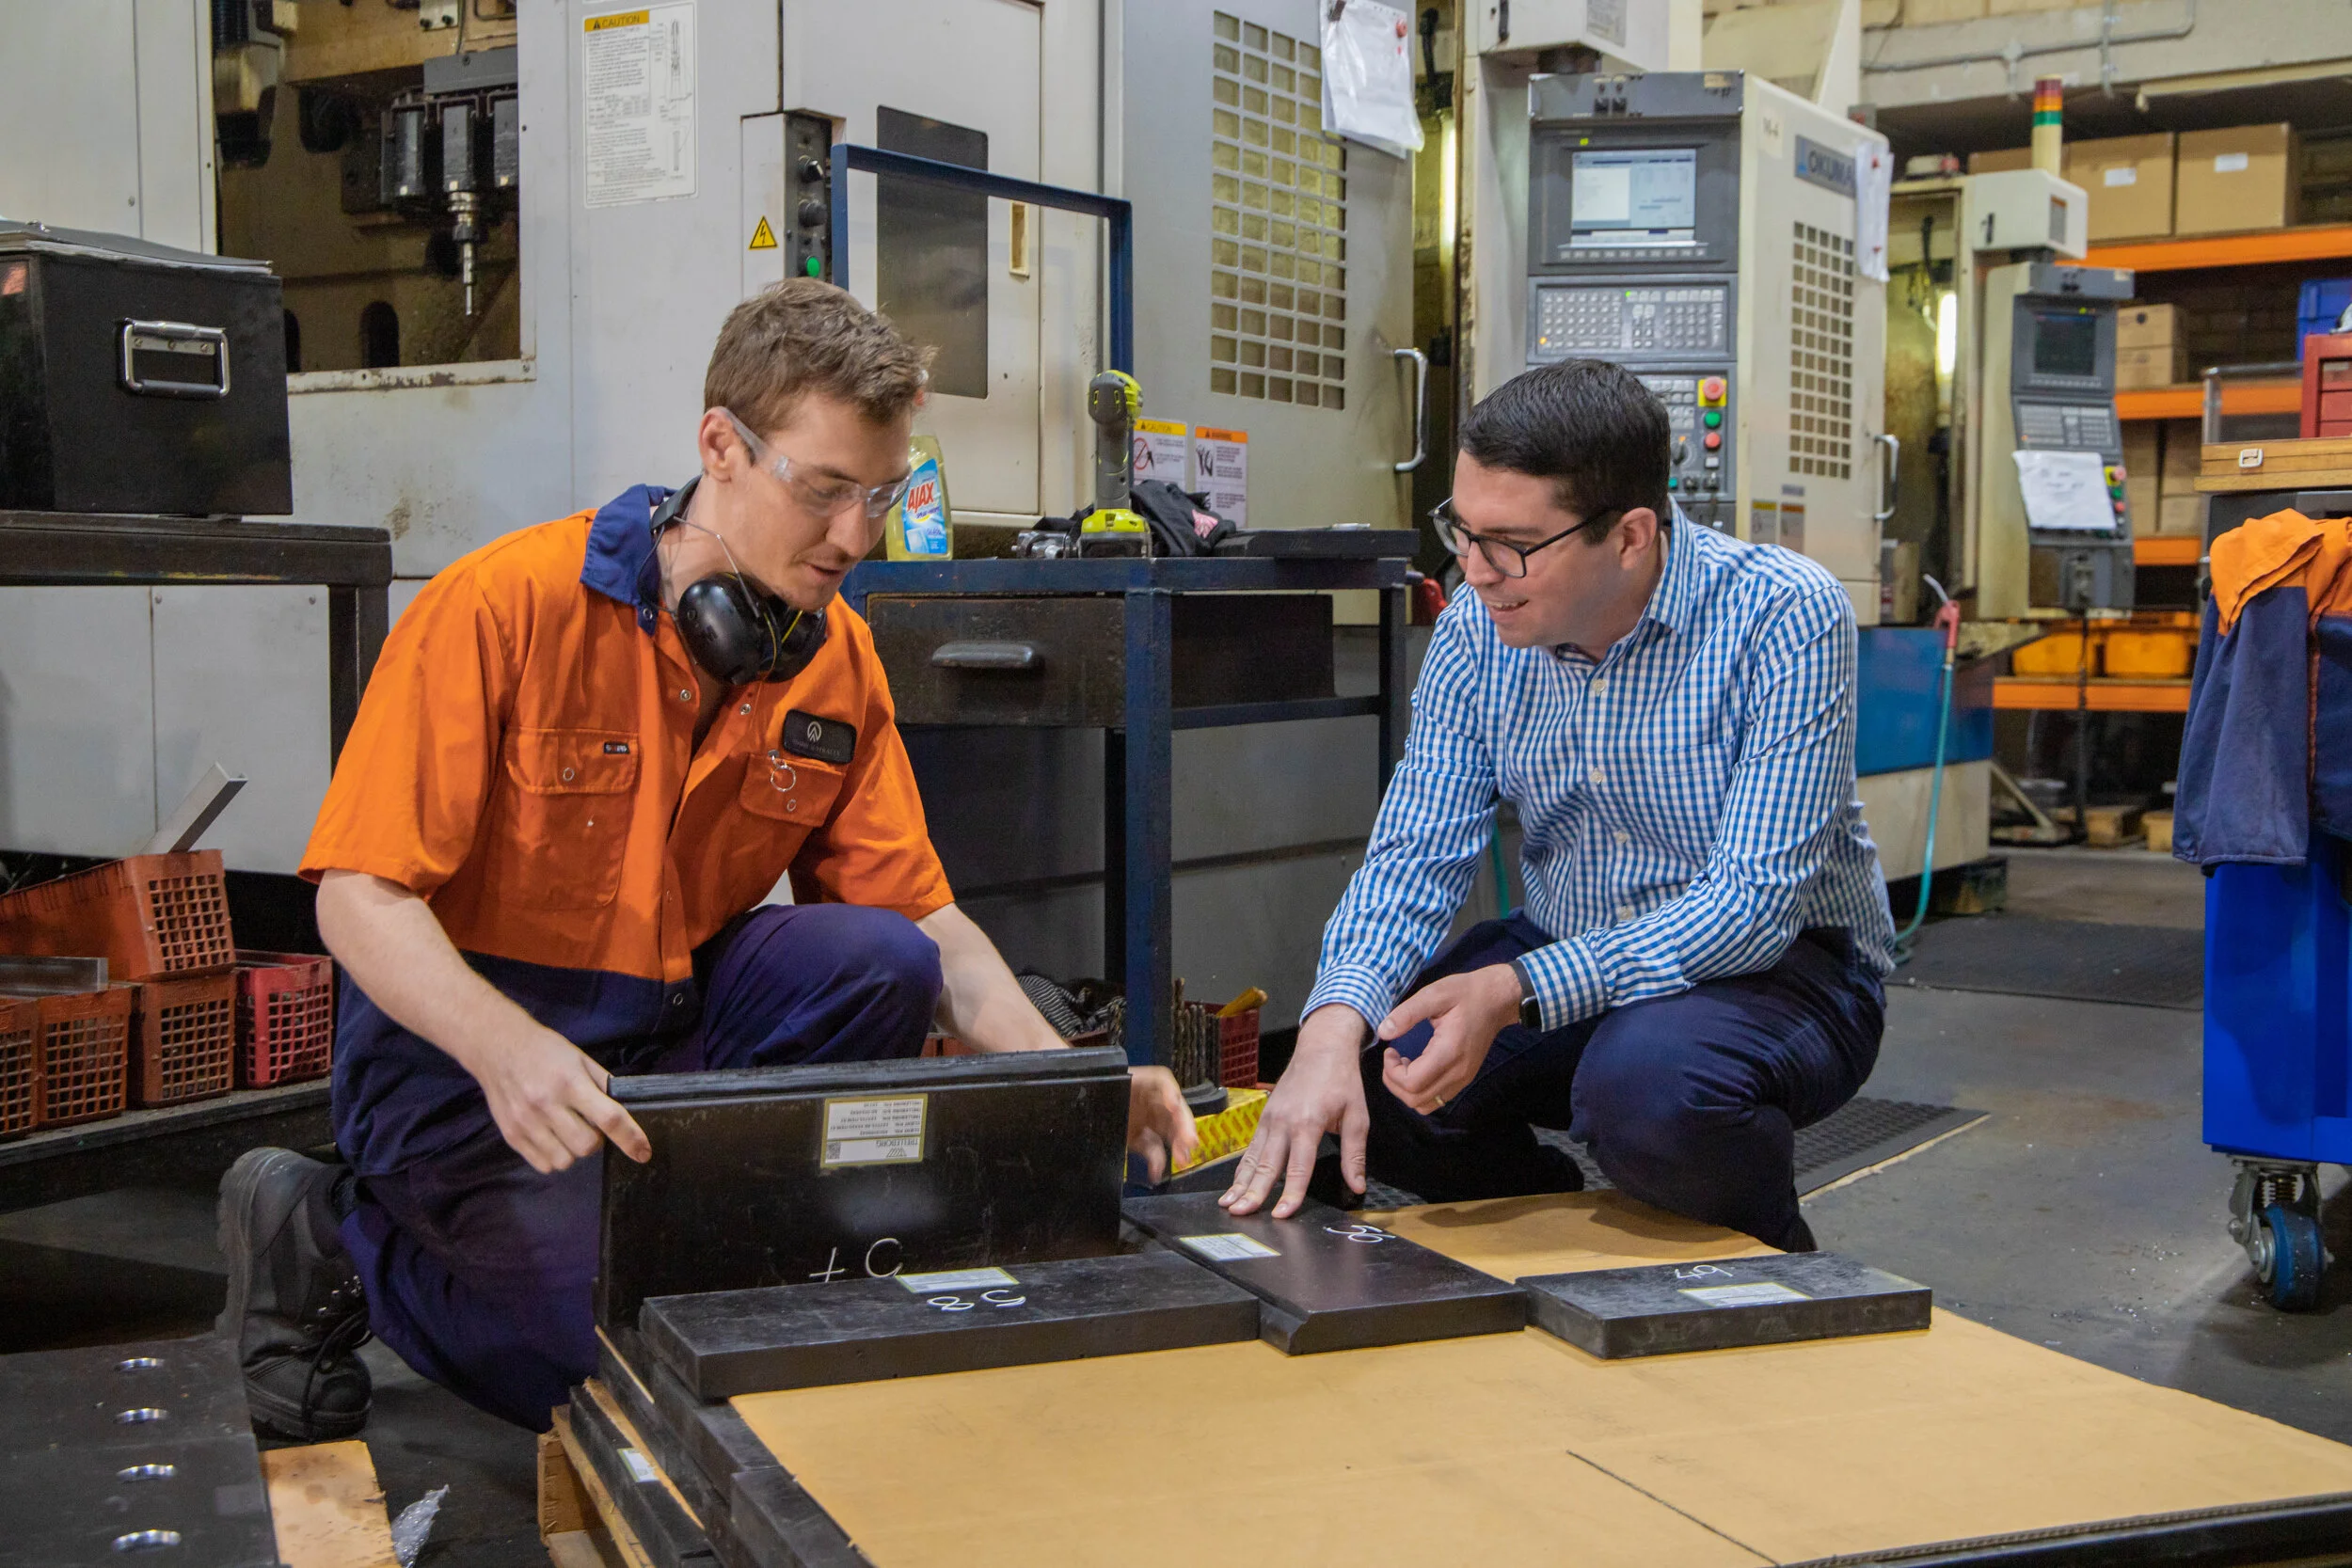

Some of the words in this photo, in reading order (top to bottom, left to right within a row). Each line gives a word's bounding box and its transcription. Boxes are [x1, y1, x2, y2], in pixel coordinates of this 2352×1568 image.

[601, 14, 640, 27] CAUTION
[906, 482, 934, 514] AJAX
[876, 1138, 918, 1148] TRELLEBORG
